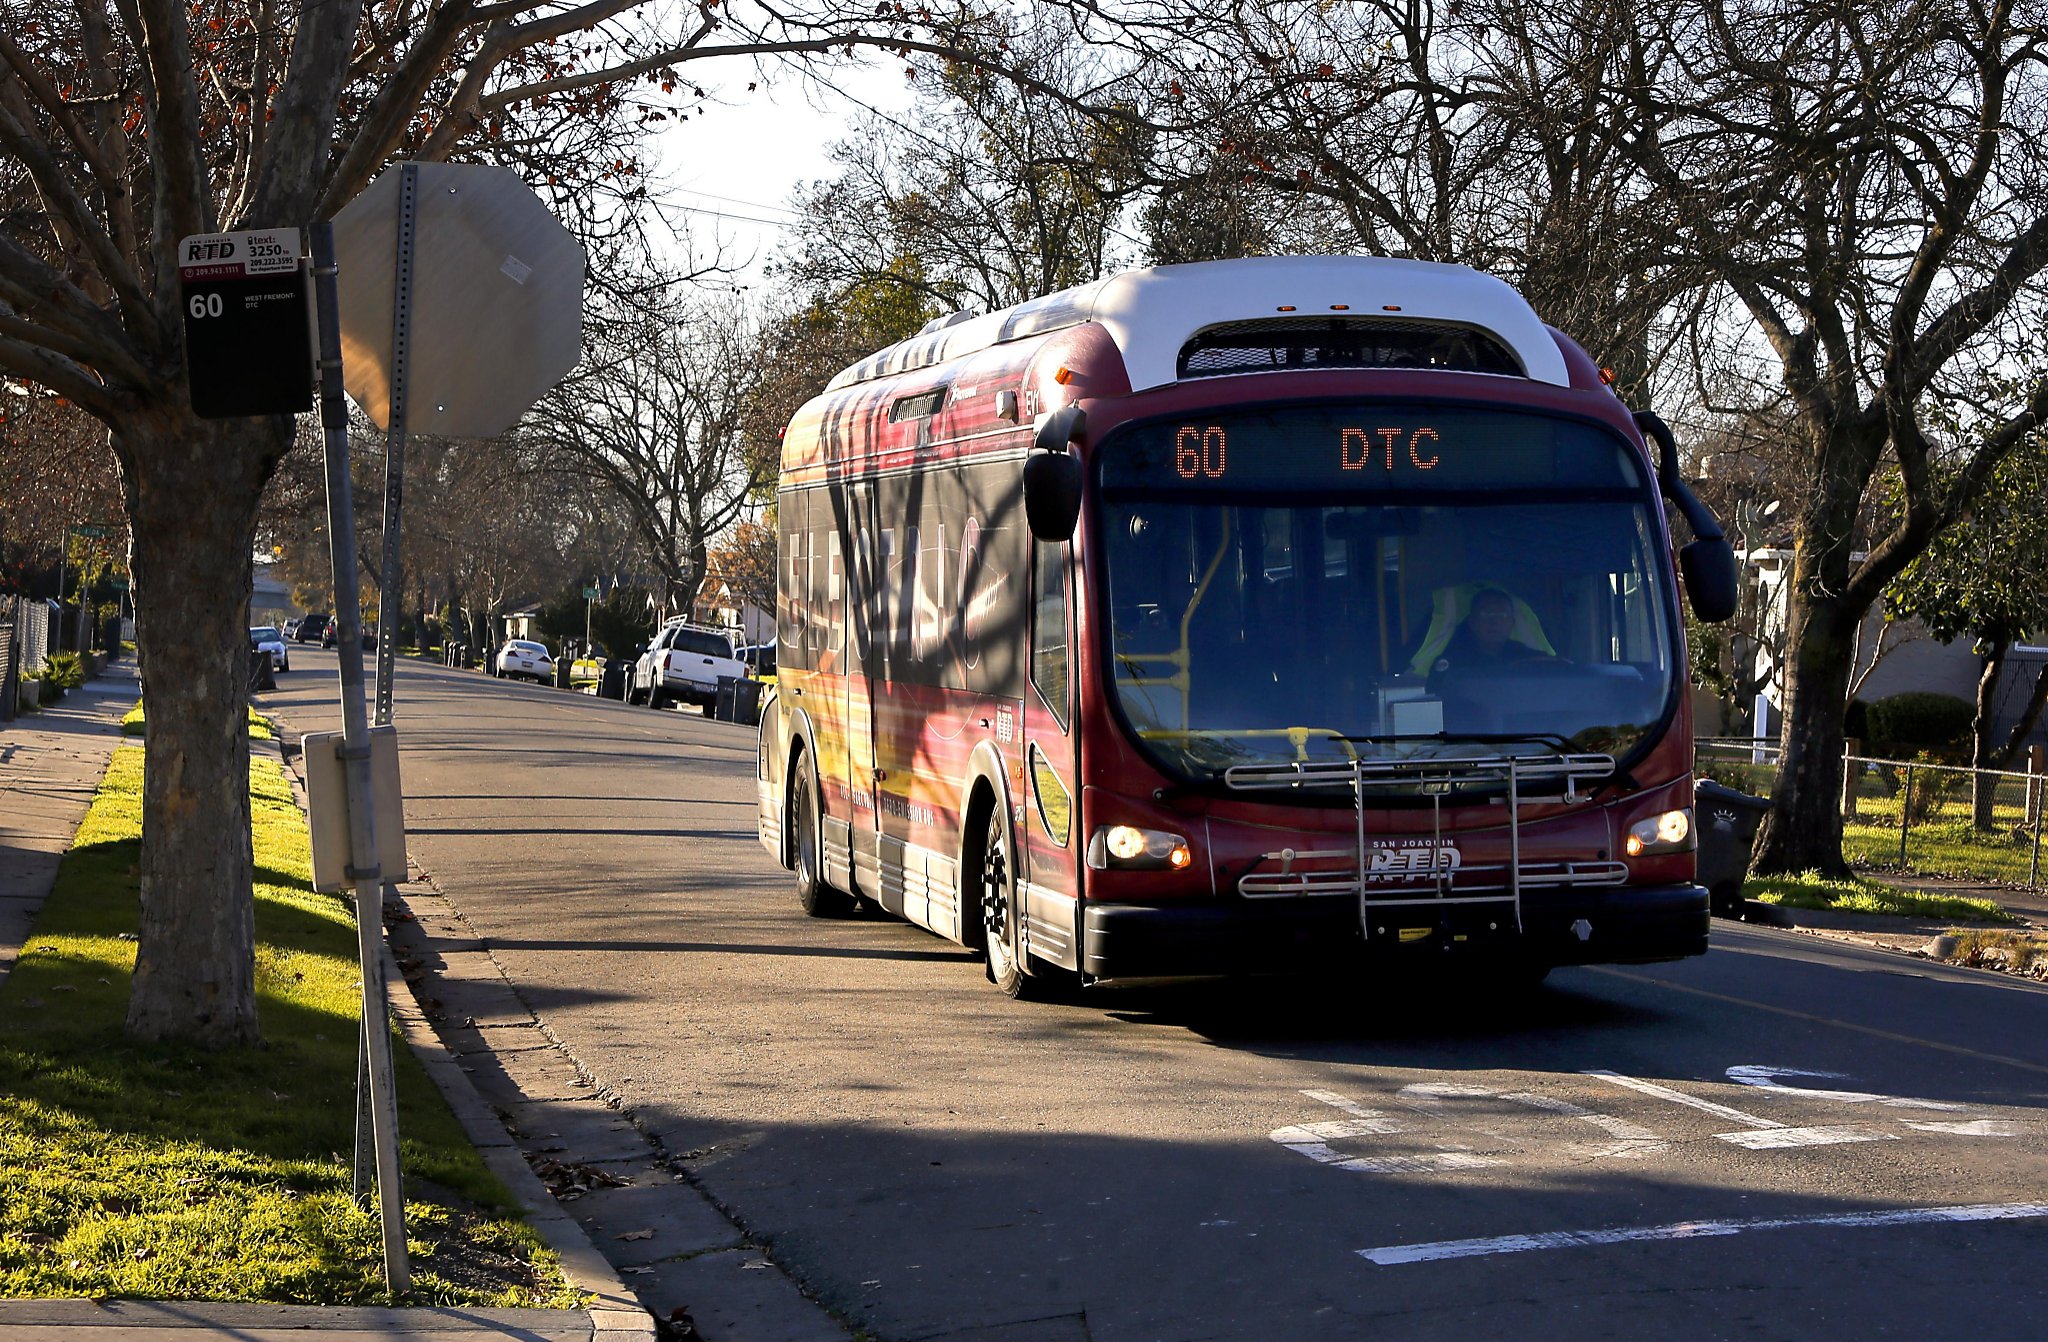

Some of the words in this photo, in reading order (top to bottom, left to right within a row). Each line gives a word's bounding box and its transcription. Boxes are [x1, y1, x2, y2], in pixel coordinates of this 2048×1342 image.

[249, 244, 282, 257] 3250
[254, 236, 276, 245] text:
[188, 243, 235, 261] RTD
[250, 257, 293, 267] 209.222.3595
[189, 293, 223, 319] 60
[1177, 426, 1226, 478] 60
[1342, 427, 1439, 470] DTC
[788, 516, 981, 670] ELECTRIC
[1367, 847, 1461, 882] RTD
